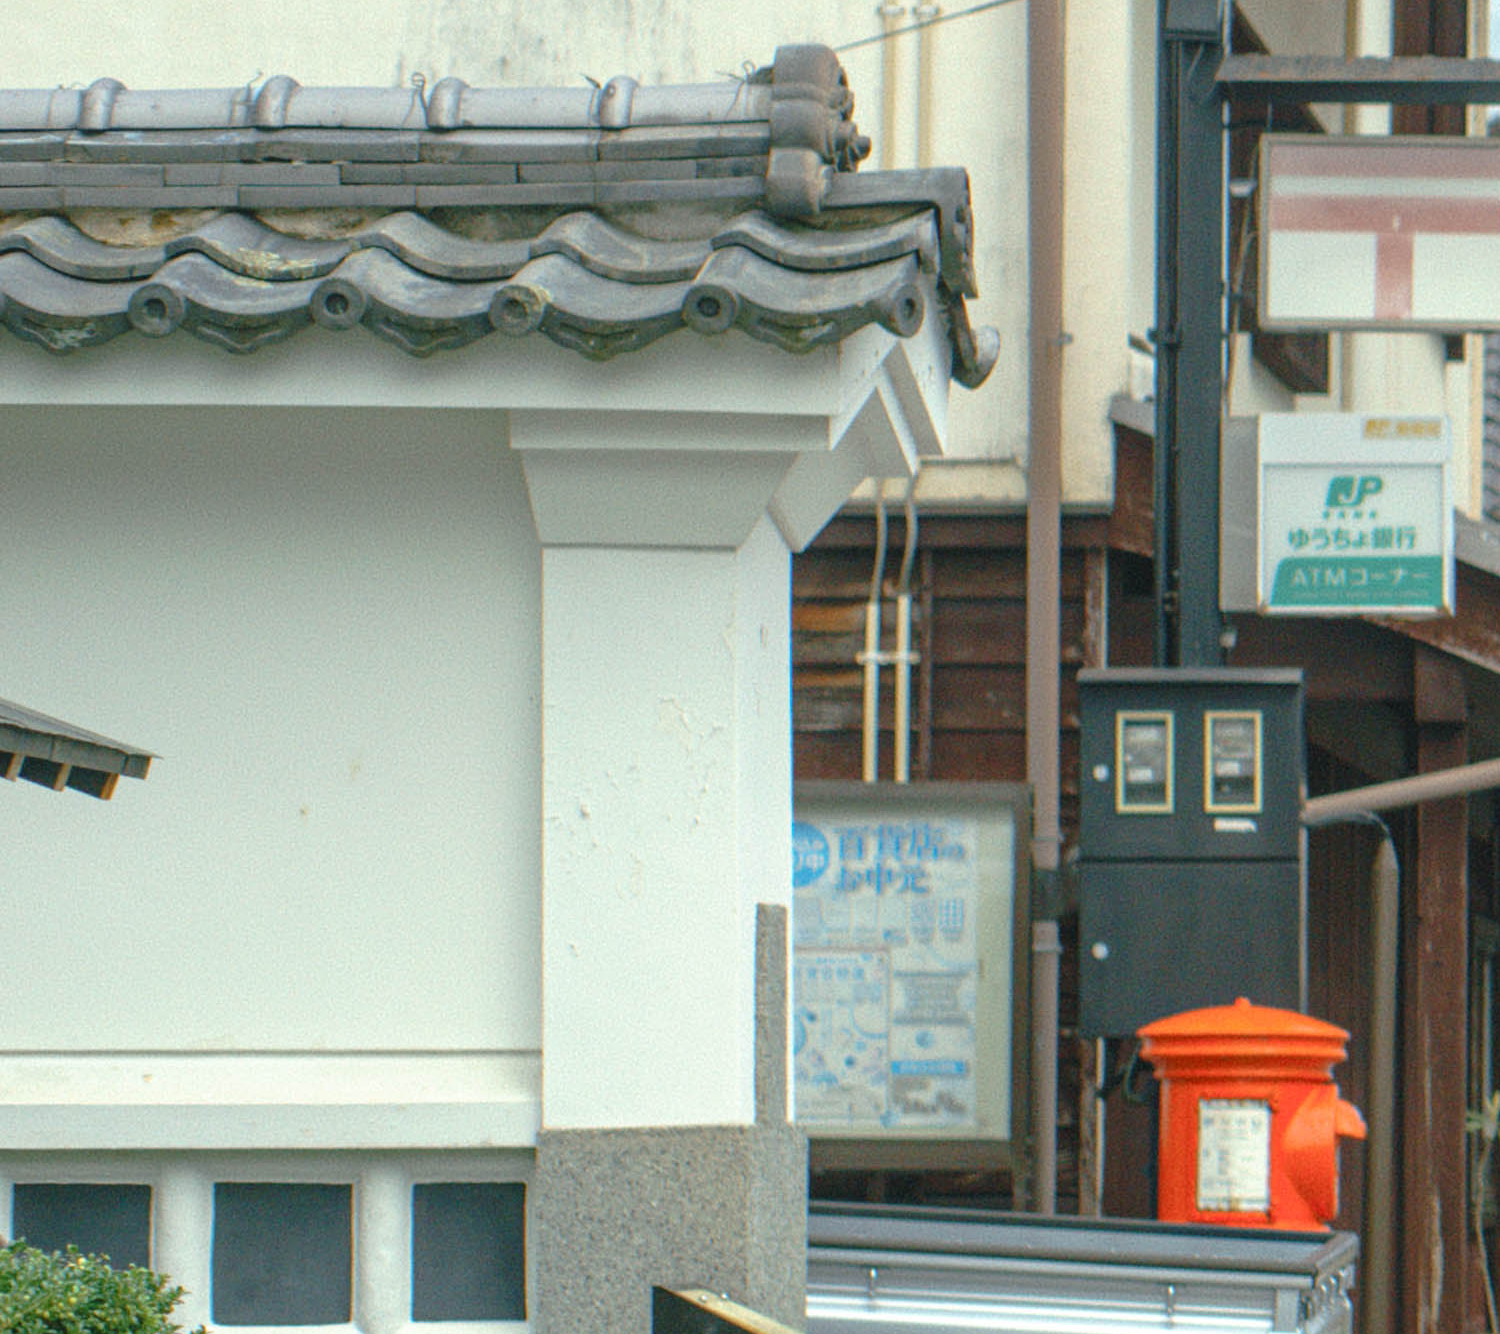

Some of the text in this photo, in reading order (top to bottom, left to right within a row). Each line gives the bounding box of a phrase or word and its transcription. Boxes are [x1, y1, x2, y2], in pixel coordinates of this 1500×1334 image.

[1288, 525, 1417, 550] ゆうちょ銀行
[1290, 567, 1431, 589] ATMコーナー
